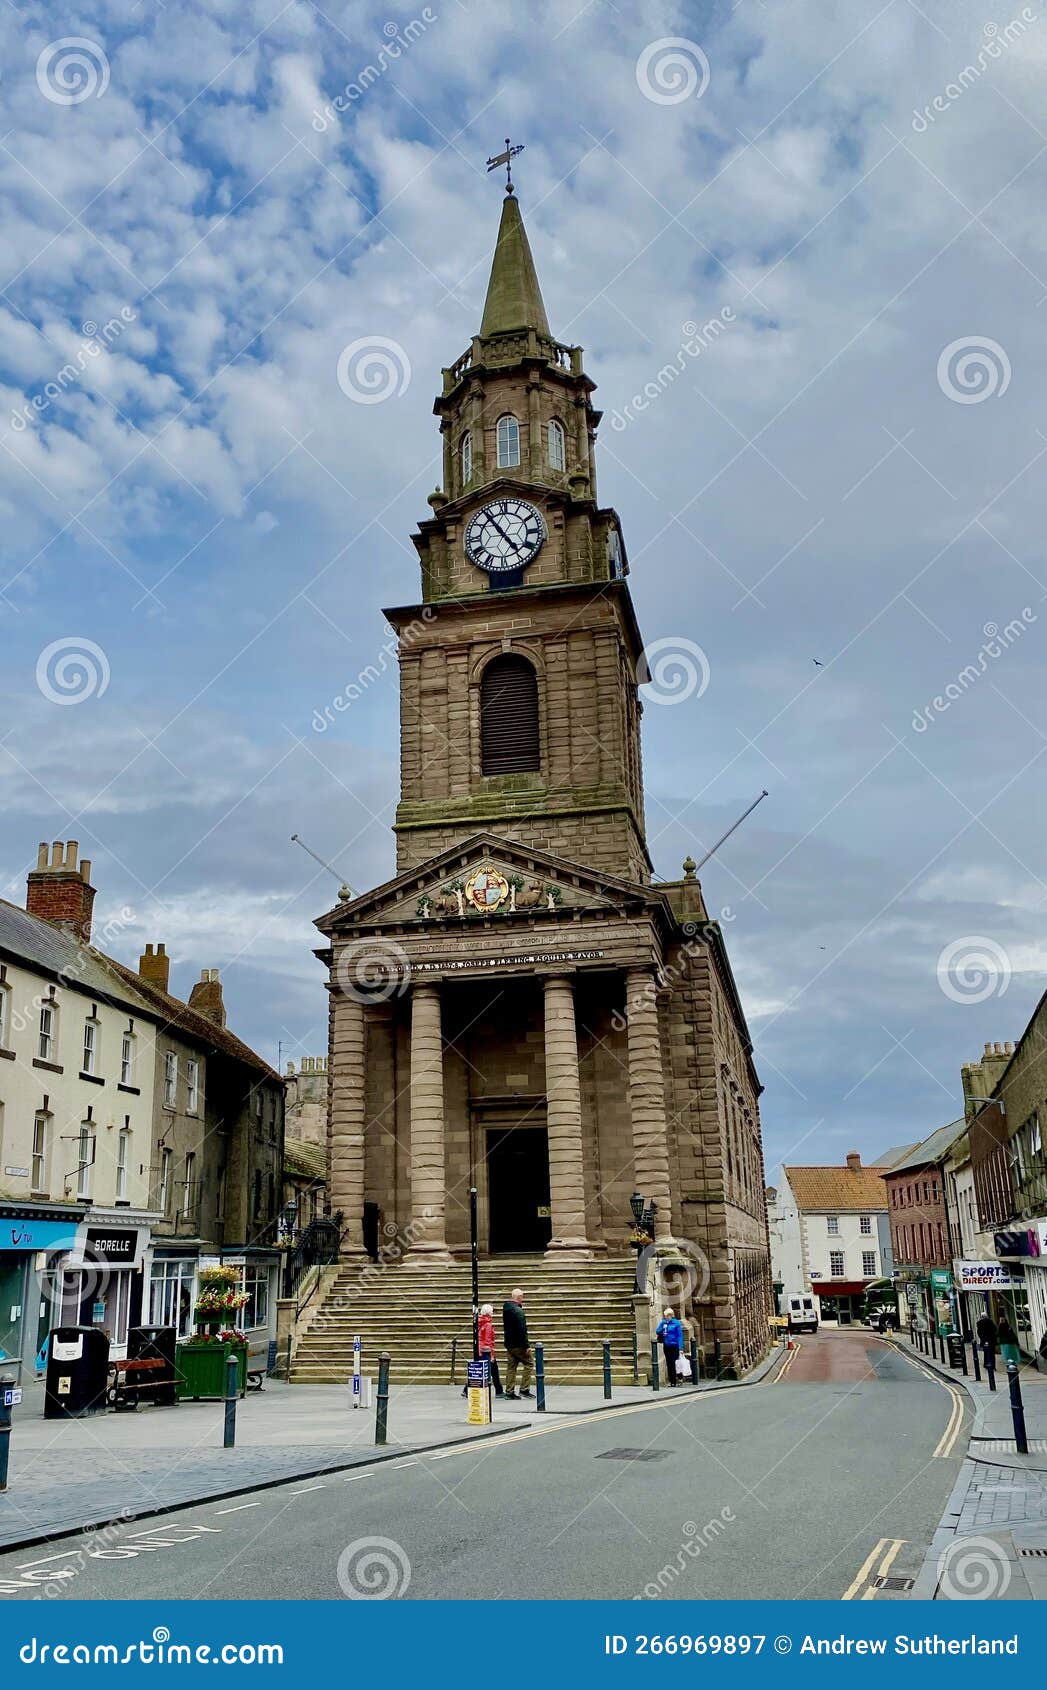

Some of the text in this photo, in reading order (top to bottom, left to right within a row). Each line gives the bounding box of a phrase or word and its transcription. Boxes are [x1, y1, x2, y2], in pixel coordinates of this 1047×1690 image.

[94, 1239, 130, 1252] SORELLE
[962, 1266, 1010, 1277] SPORTS
[89, 1524, 222, 1560] ONLY
